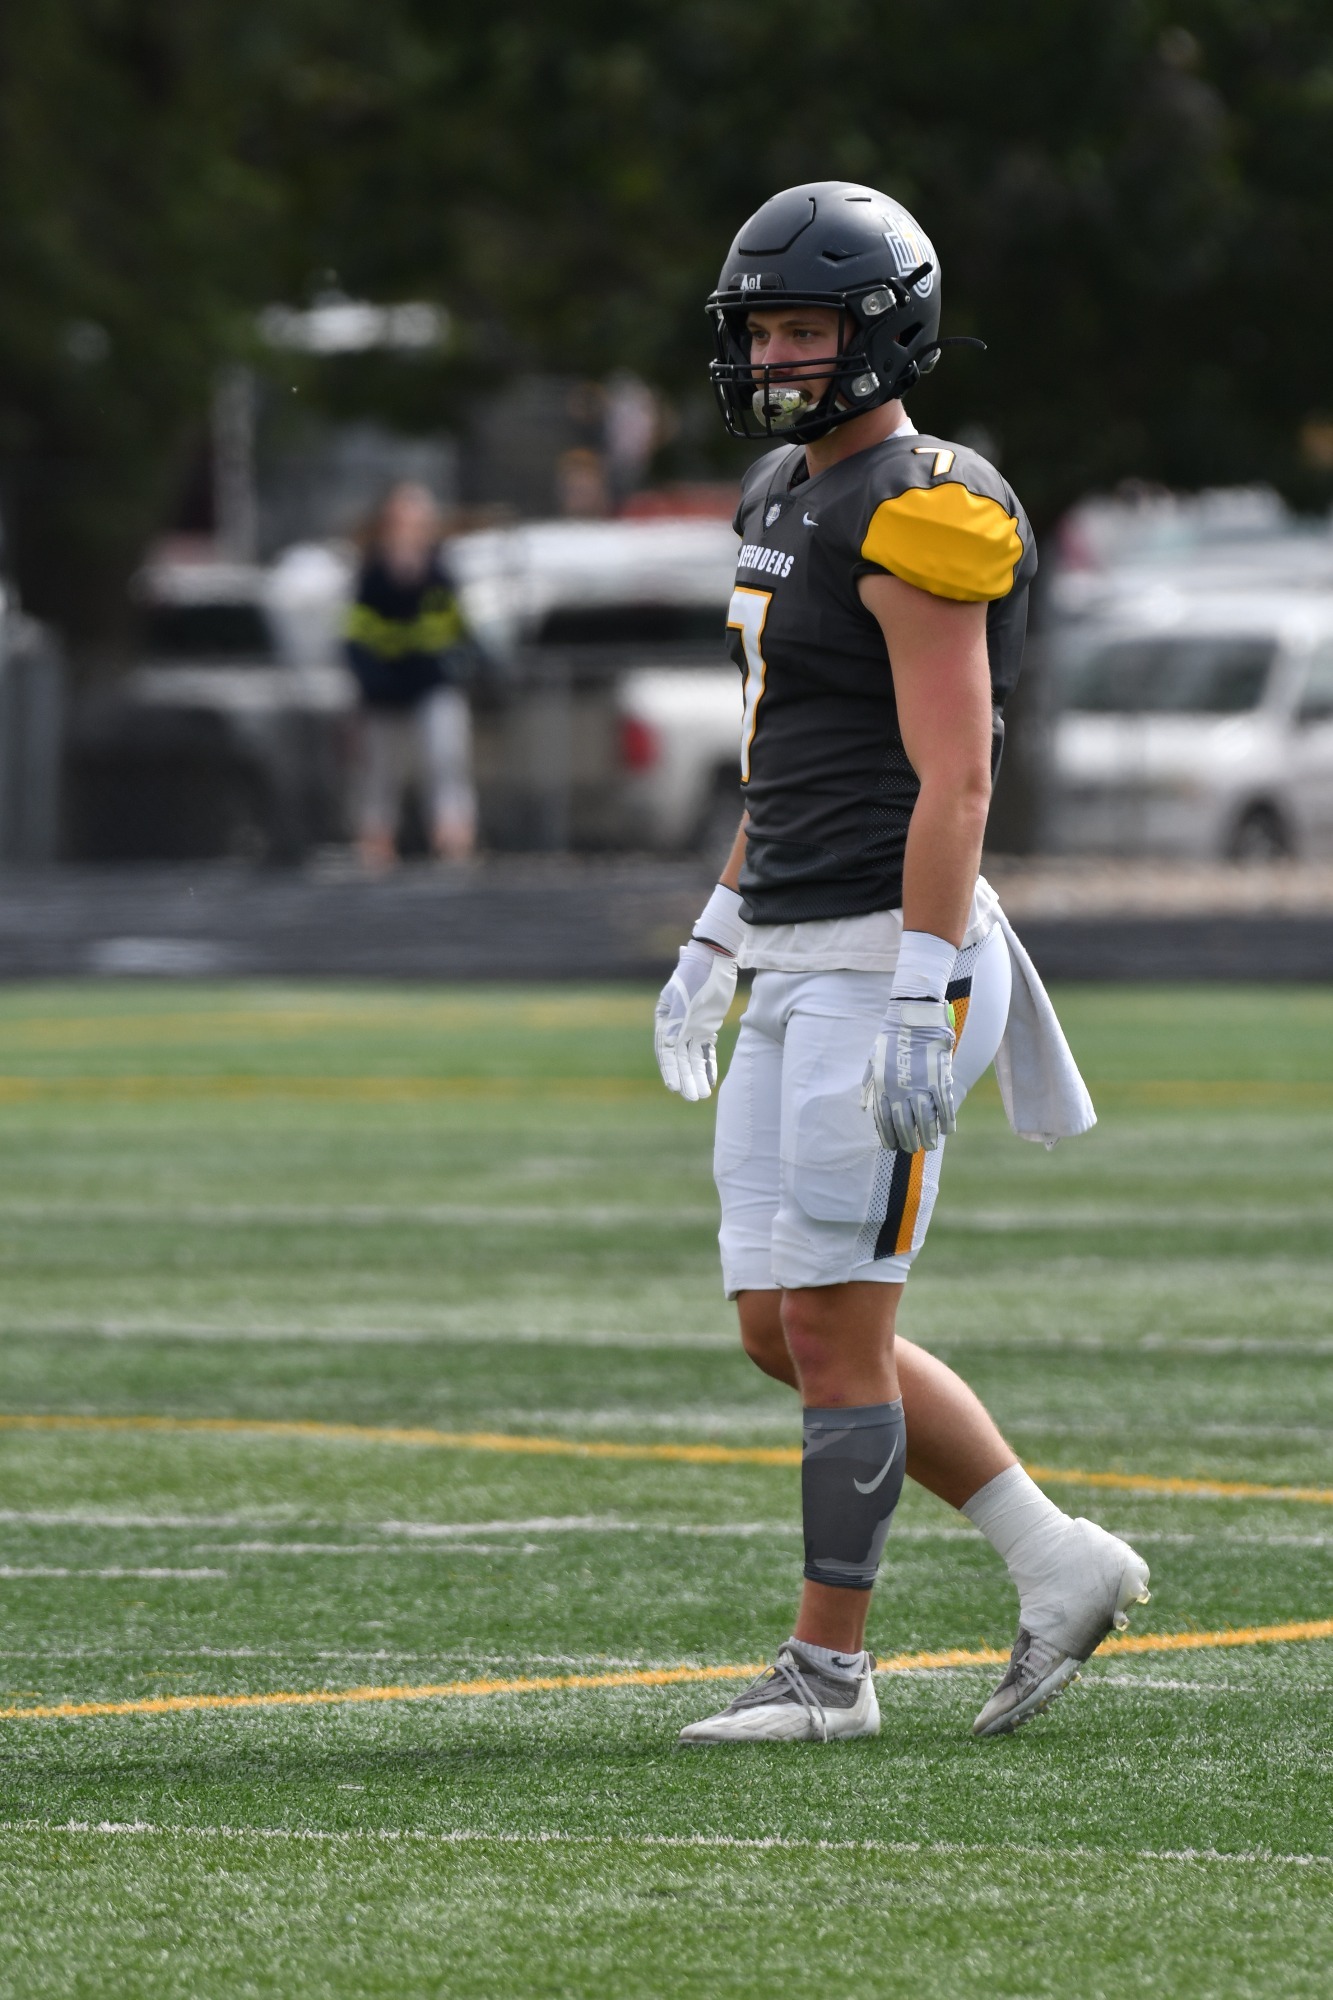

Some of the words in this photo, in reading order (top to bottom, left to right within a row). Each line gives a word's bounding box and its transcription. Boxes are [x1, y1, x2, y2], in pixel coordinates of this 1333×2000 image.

[911, 447, 956, 478] 7
[738, 544, 795, 578] DEFENDERS
[726, 583, 774, 785] 7
